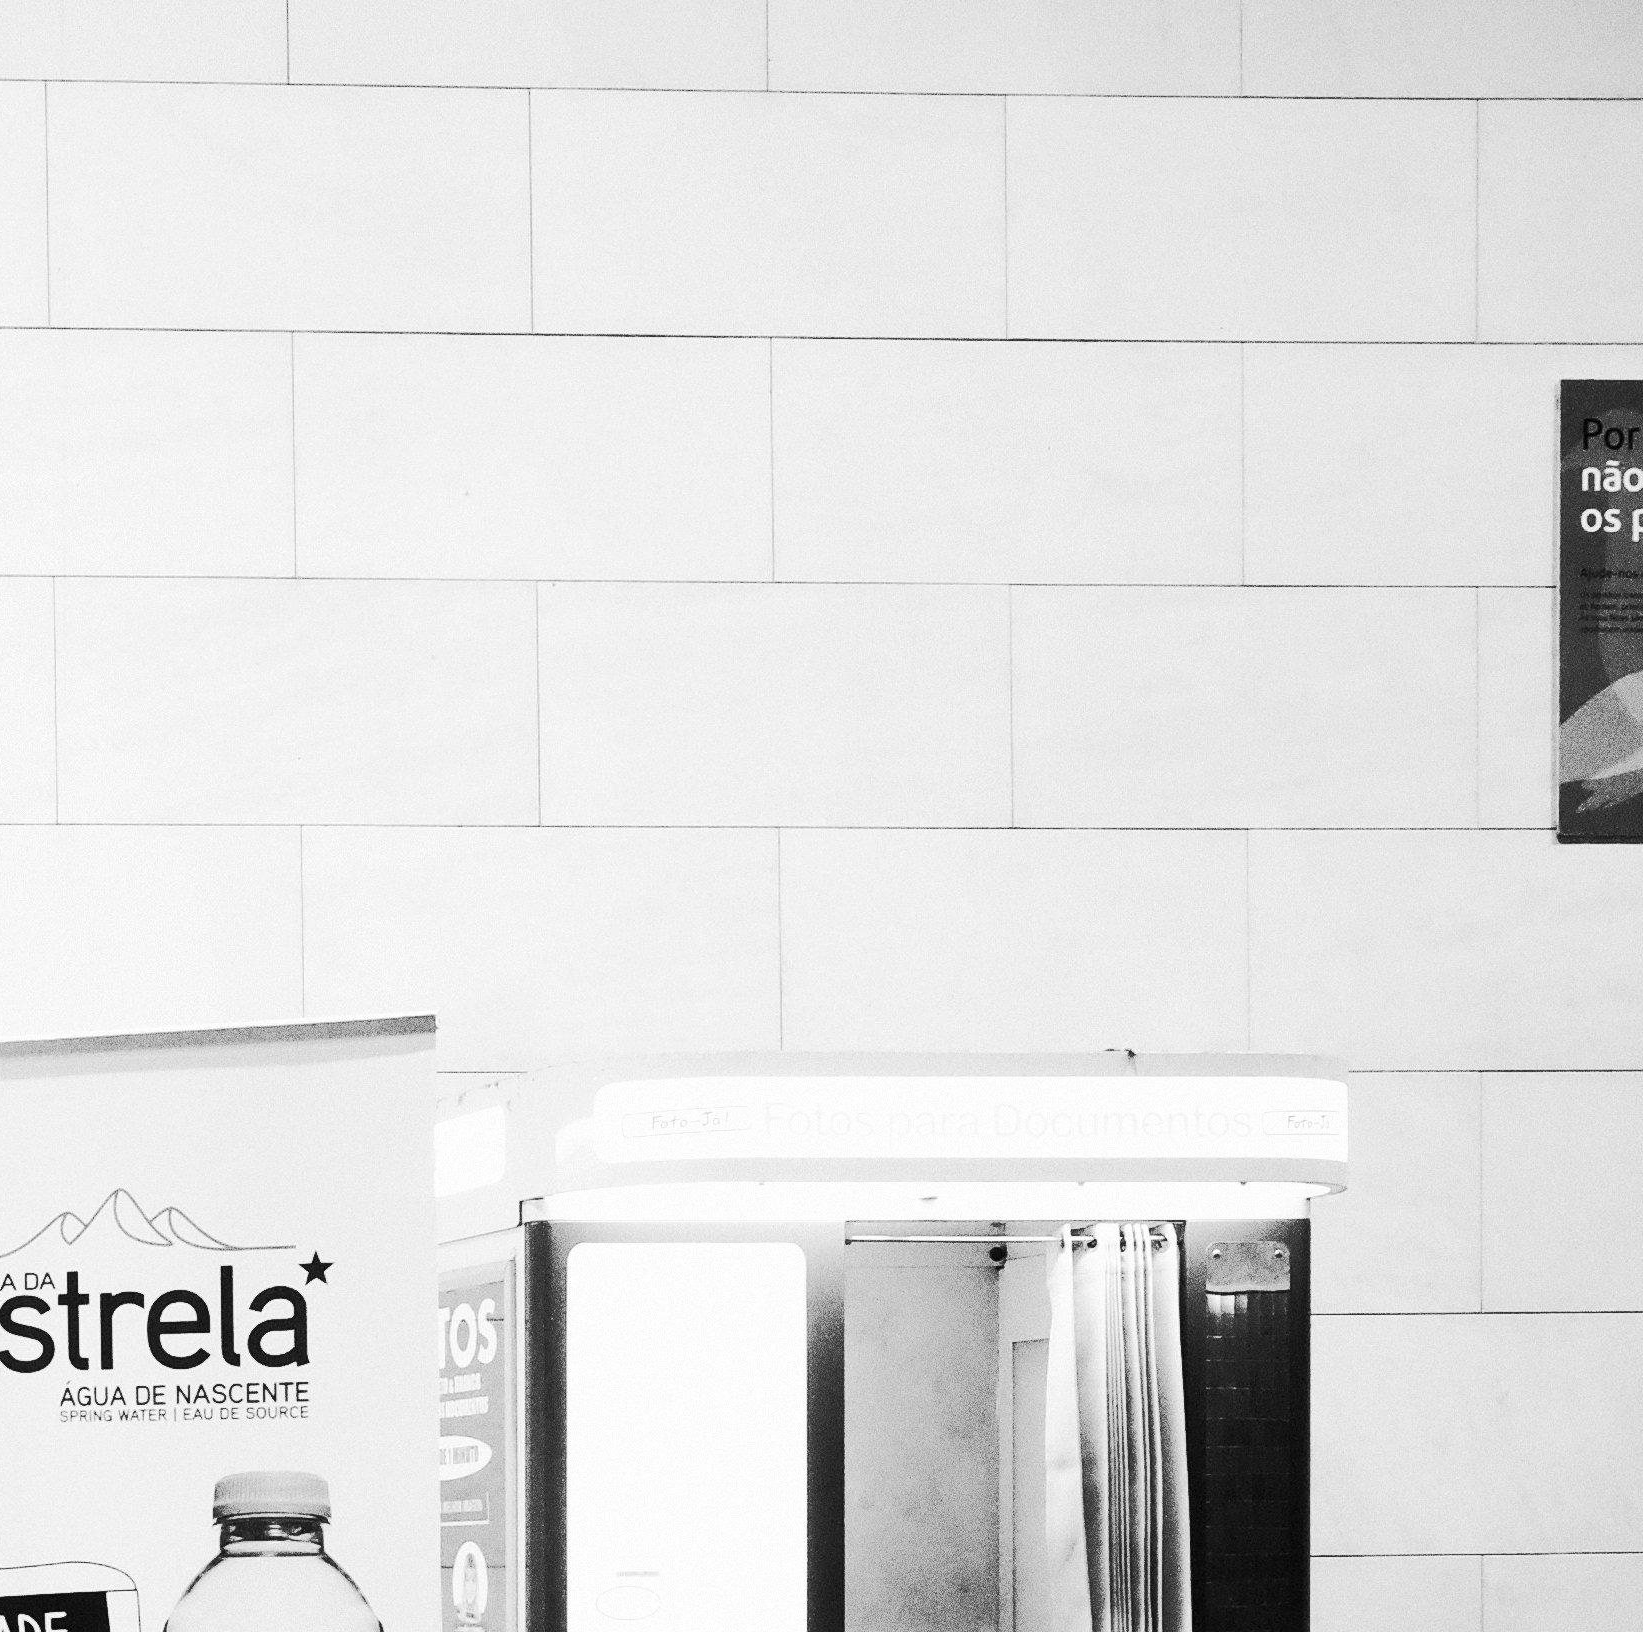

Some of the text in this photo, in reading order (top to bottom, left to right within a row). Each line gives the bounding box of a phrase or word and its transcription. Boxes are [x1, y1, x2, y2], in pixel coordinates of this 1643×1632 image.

[1582, 418, 1641, 451] Por
[1580, 507, 1622, 534] os
[765, 1102, 875, 1138] Fotos
[993, 1102, 1253, 1139] Documentos
[24, 1272, 56, 1291] DA
[60, 1380, 310, 1409] ÁGUA DE NASCENTE
[60, 1405, 310, 1423] SPRING WATER EAU DE SOURCE
